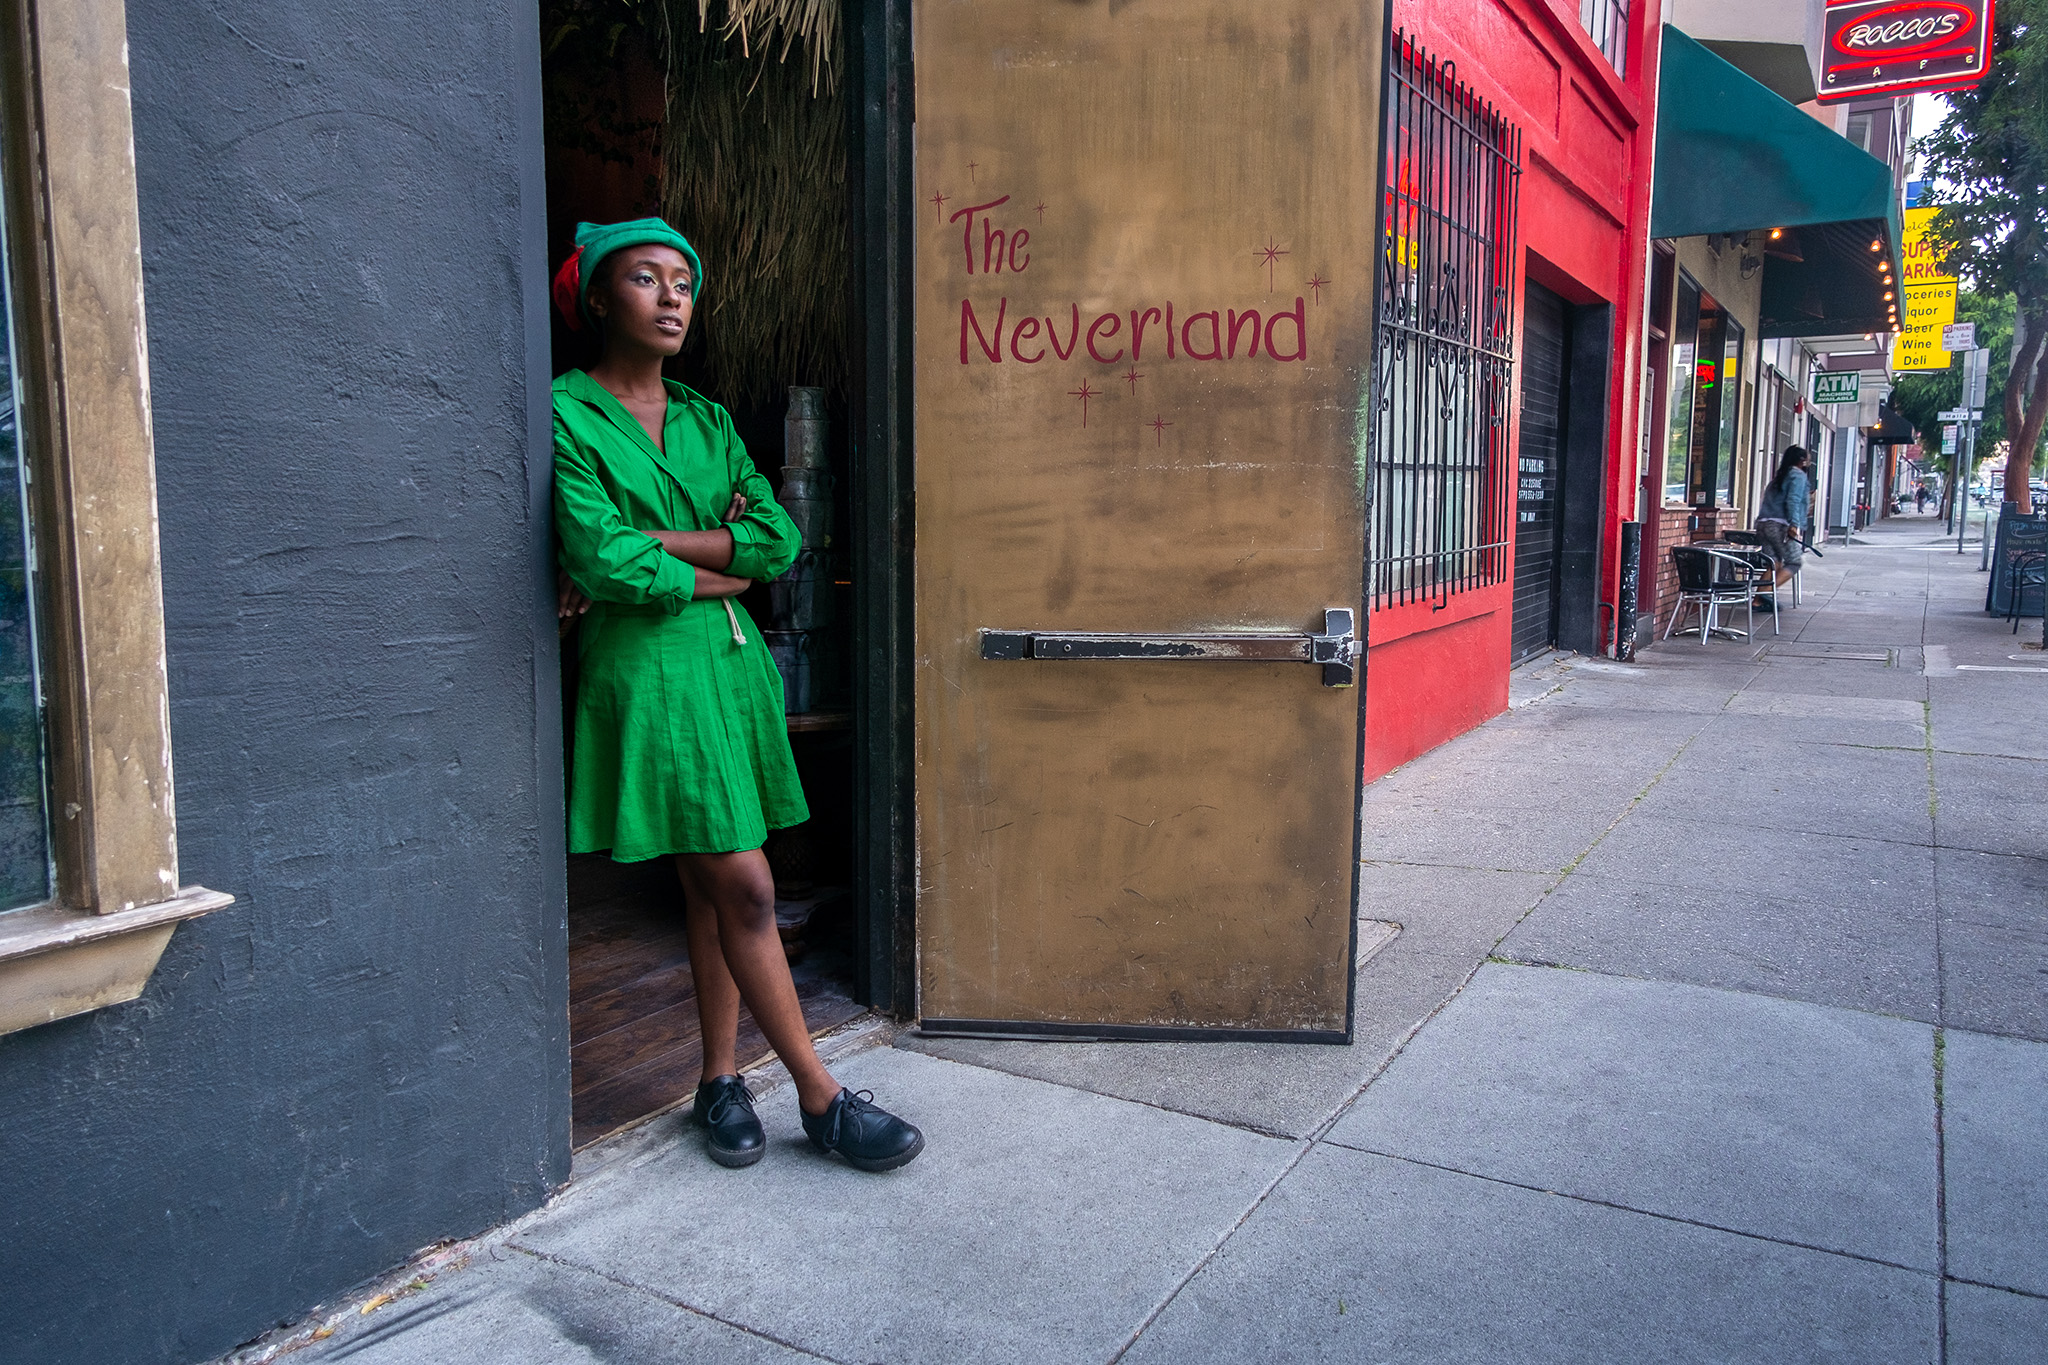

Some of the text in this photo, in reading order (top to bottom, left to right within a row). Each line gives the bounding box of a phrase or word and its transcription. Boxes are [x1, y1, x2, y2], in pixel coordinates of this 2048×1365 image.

[1846, 13, 1960, 47] ROCCO'S
[949, 194, 1031, 275] The
[1905, 288, 1952, 300] oceries
[1906, 306, 1939, 318] iquor
[959, 296, 1307, 365] Neverland
[1905, 323, 1934, 334] Beer
[1902, 339, 1932, 349] Wine
[1903, 355, 1927, 366] Deli
[1816, 374, 1858, 392] ATM
[1526, 458, 1544, 473] PARKING
